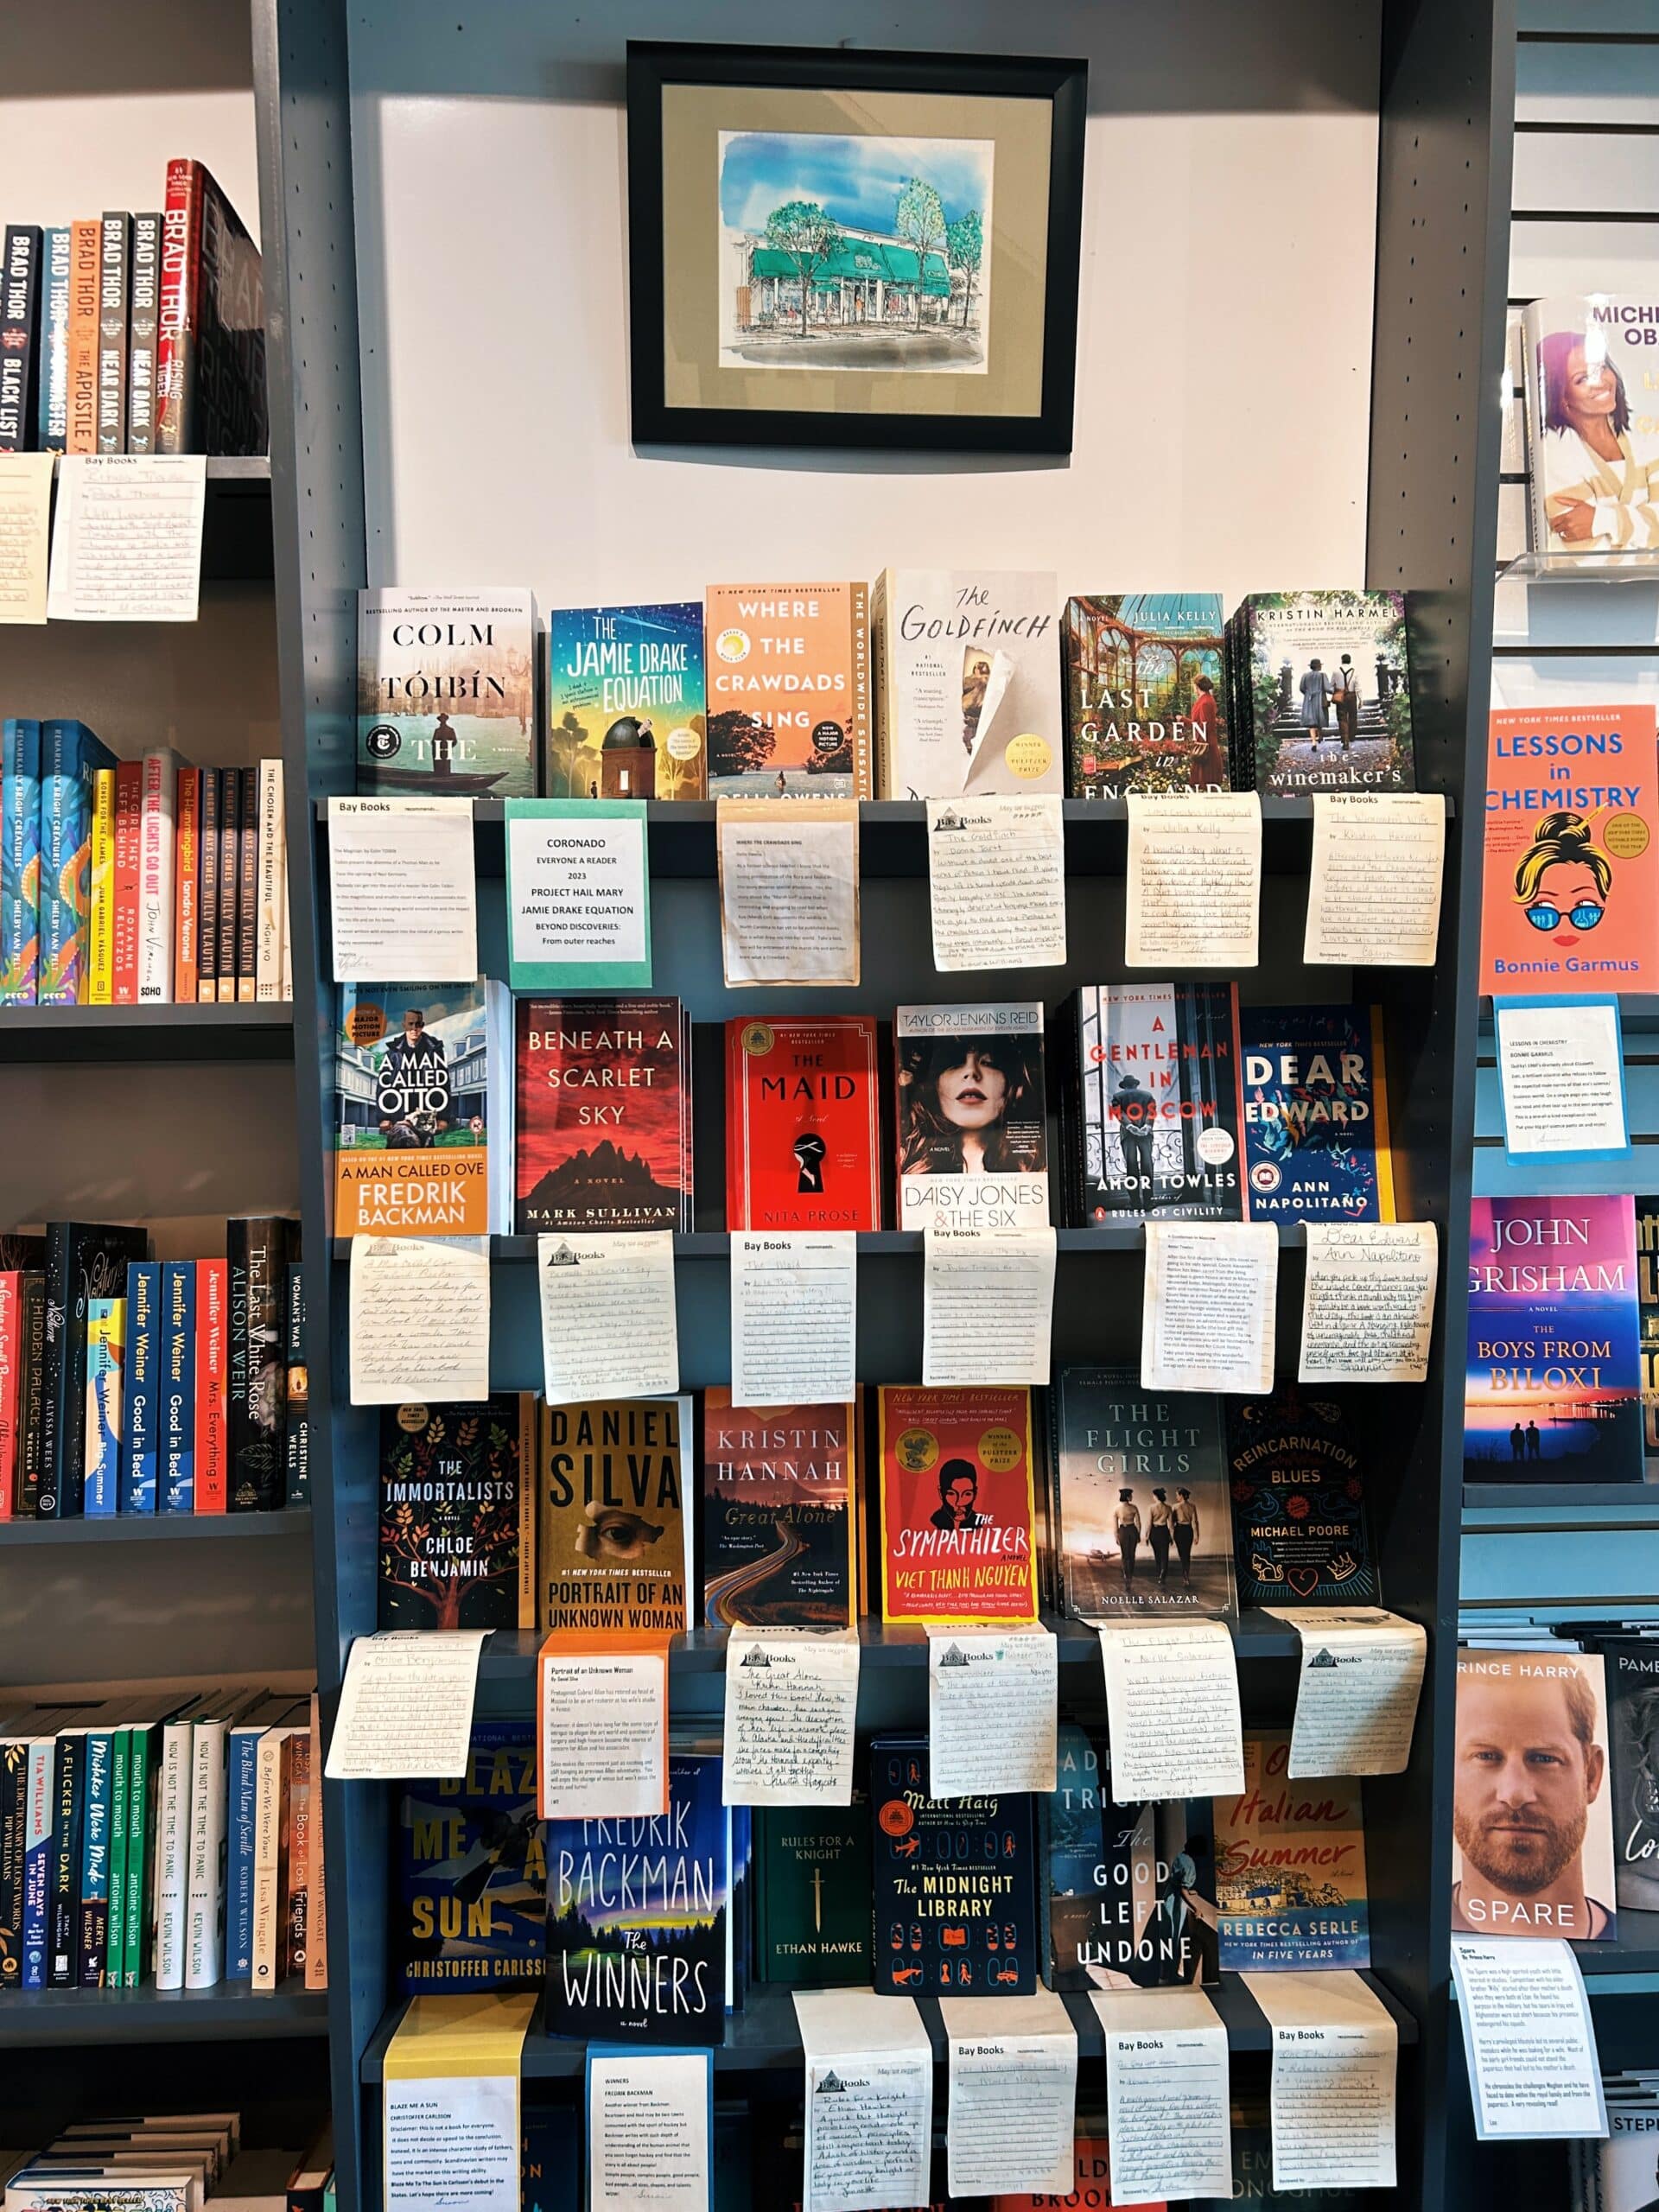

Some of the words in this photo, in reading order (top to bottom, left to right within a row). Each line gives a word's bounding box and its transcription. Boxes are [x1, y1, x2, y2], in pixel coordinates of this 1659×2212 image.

[164, 209, 187, 272] BRAD
[160, 283, 186, 341] THOR
[101, 350, 119, 386] NEAR
[169, 359, 184, 399] RISING
[157, 364, 168, 397] TIGER
[100, 391, 119, 428] DARK
[955, 586, 989, 608] The
[738, 601, 819, 618] WHERE
[1134, 611, 1171, 624] JULIA
[1177, 610, 1217, 625] KELLY
[391, 624, 493, 646] COLM
[567, 641, 633, 678] JAMIE
[639, 643, 689, 673] DRAKE
[381, 670, 505, 699] TÓIBÍN
[603, 674, 683, 713] EQUATION
[715, 673, 846, 692] CRAWDADS
[1081, 689, 1154, 709] LAST
[752, 711, 810, 728] SING
[1571, 714, 1621, 722] BESTSELLER
[1081, 721, 1208, 742] GARDEN
[1497, 733, 1623, 757] LESSONS
[147, 759, 162, 790] AFTER
[183, 778, 194, 796] The
[1485, 786, 1641, 810] CHEMISTRY
[146, 793, 160, 813] THE
[339, 802, 357, 813] Bay
[360, 802, 391, 812] Books
[1330, 795, 1347, 804] Bay
[1350, 795, 1378, 804] Books
[145, 816, 160, 854] LIGHTS
[182, 798, 194, 873] Hummingbird
[546, 838, 606, 849] CORONADO
[145, 856, 159, 871] GO
[537, 856, 577, 865] EVERYONE
[586, 856, 617, 865] READER
[145, 874, 159, 895] OUT
[531, 888, 570, 898] PROJECT
[572, 888, 594, 897] HAIL
[595, 888, 624, 897] MARY
[203, 890, 214, 922] WILLY
[521, 906, 550, 915] JAMIE
[551, 906, 582, 915] DRAKE
[586, 906, 634, 916] EQUATION
[569, 923, 621, 931] DISCOVERIES:
[201, 926, 214, 974] VLAUTIN
[1494, 958, 1560, 974] Bonnie
[1565, 957, 1639, 972] Garmus
[528, 1031, 643, 1051] BENEATH
[656, 1031, 674, 1049] A
[1090, 1041, 1229, 1063] GENTLEMAN
[379, 1054, 393, 1071] A
[400, 1052, 448, 1071] MAN
[1246, 1055, 1367, 1086] DEAR
[378, 1071, 448, 1089] CALLED
[548, 1067, 655, 1089] SCARLET
[762, 1076, 856, 1101] MAID
[378, 1088, 448, 1114] OTTO
[1109, 1102, 1217, 1121] MOSCOW
[1245, 1101, 1370, 1123] EDWARD
[578, 1106, 625, 1125] SKY
[1096, 1175, 1151, 1191] AMOR
[1160, 1173, 1236, 1190] TOWLES
[359, 1181, 467, 1206] FREDRIK
[905, 1185, 964, 1207] DAISY
[968, 1185, 1043, 1206] JONES
[359, 1207, 466, 1226] BACKMAN
[1322, 1228, 1366, 1245] Dear
[1369, 1230, 1421, 1246] Edward
[1491, 1218, 1590, 1253] JOHN
[250, 1245, 267, 1278] The
[1326, 1247, 1354, 1260] Ann
[1362, 1249, 1422, 1263] Napolitano
[173, 1272, 186, 1327] Jennifer
[249, 1285, 265, 1318] Last
[171, 1332, 185, 1382] Weiner
[249, 1323, 265, 1376] White
[1478, 1341, 1535, 1358] BOYS
[1543, 1341, 1611, 1358] FROM
[1490, 1367, 1602, 1391] BILOXI
[248, 1380, 264, 1421] Rose
[169, 1395, 182, 1432] Good
[550, 1410, 678, 1447] DANIEL
[717, 1429, 841, 1449] KRISTIN
[1085, 1428, 1200, 1448] FLIGHT
[169, 1436, 181, 1448] in
[168, 1452, 181, 1478] Bed
[1097, 1453, 1191, 1473] GIRLS
[1233, 1436, 1358, 1472] REINCARNATION
[550, 1453, 680, 1509] SILVA
[717, 1460, 842, 1481] HANNAH
[1271, 1470, 1321, 1484] BLUES
[387, 1481, 513, 1502] IMMORTALISTS
[893, 1526, 1029, 1557] SYMPATHIZER
[895, 1570, 925, 1589] VIET
[929, 1567, 970, 1589] THANH
[975, 1564, 1029, 1588] NGUYEN
[549, 1582, 630, 1605] PORTRAIT
[637, 1582, 657, 1603] OF
[662, 1583, 683, 1605] AN
[1102, 1596, 1144, 1605] NOELLE
[1148, 1595, 1200, 1605] SALAZAR
[549, 1609, 624, 1630] UNKNOWN
[629, 1609, 683, 1630] WOMAN
[90, 1740, 108, 1796] Mistakes
[62, 1757, 73, 1816] FLICKER
[1230, 1789, 1351, 1826] Italian
[63, 1821, 69, 1830] IN
[89, 1803, 105, 1840] Were
[781, 1837, 816, 1847] RULES
[819, 1837, 842, 1847] FOR
[847, 1836, 855, 1846] A
[89, 1845, 105, 1885] Made
[795, 1849, 841, 1859] KNIGHT
[1220, 1839, 1356, 1877] Summer
[60, 1853, 69, 1892] DARK
[1093, 1861, 1169, 1886] GOOD
[893, 1878, 918, 1894] The
[923, 1875, 1014, 1894] MIDNIGHT
[412, 1896, 492, 1938] SUN
[918, 1899, 993, 1916] LIBRARY
[1100, 1902, 1166, 1925] LEFT
[1468, 1898, 1574, 1927] SPARE
[1077, 1937, 1192, 1965] UNDONE
[1252, 1950, 1264, 1960] IN
[1268, 1950, 1294, 1960] FIVE
[1298, 1949, 1333, 1959] YEARS
[406, 1960, 489, 1978] CHRISTOFFER
[563, 1949, 709, 2014] WINNERS
[1279, 2031, 1295, 2041] Bay
[1298, 2031, 1325, 2039] Books
